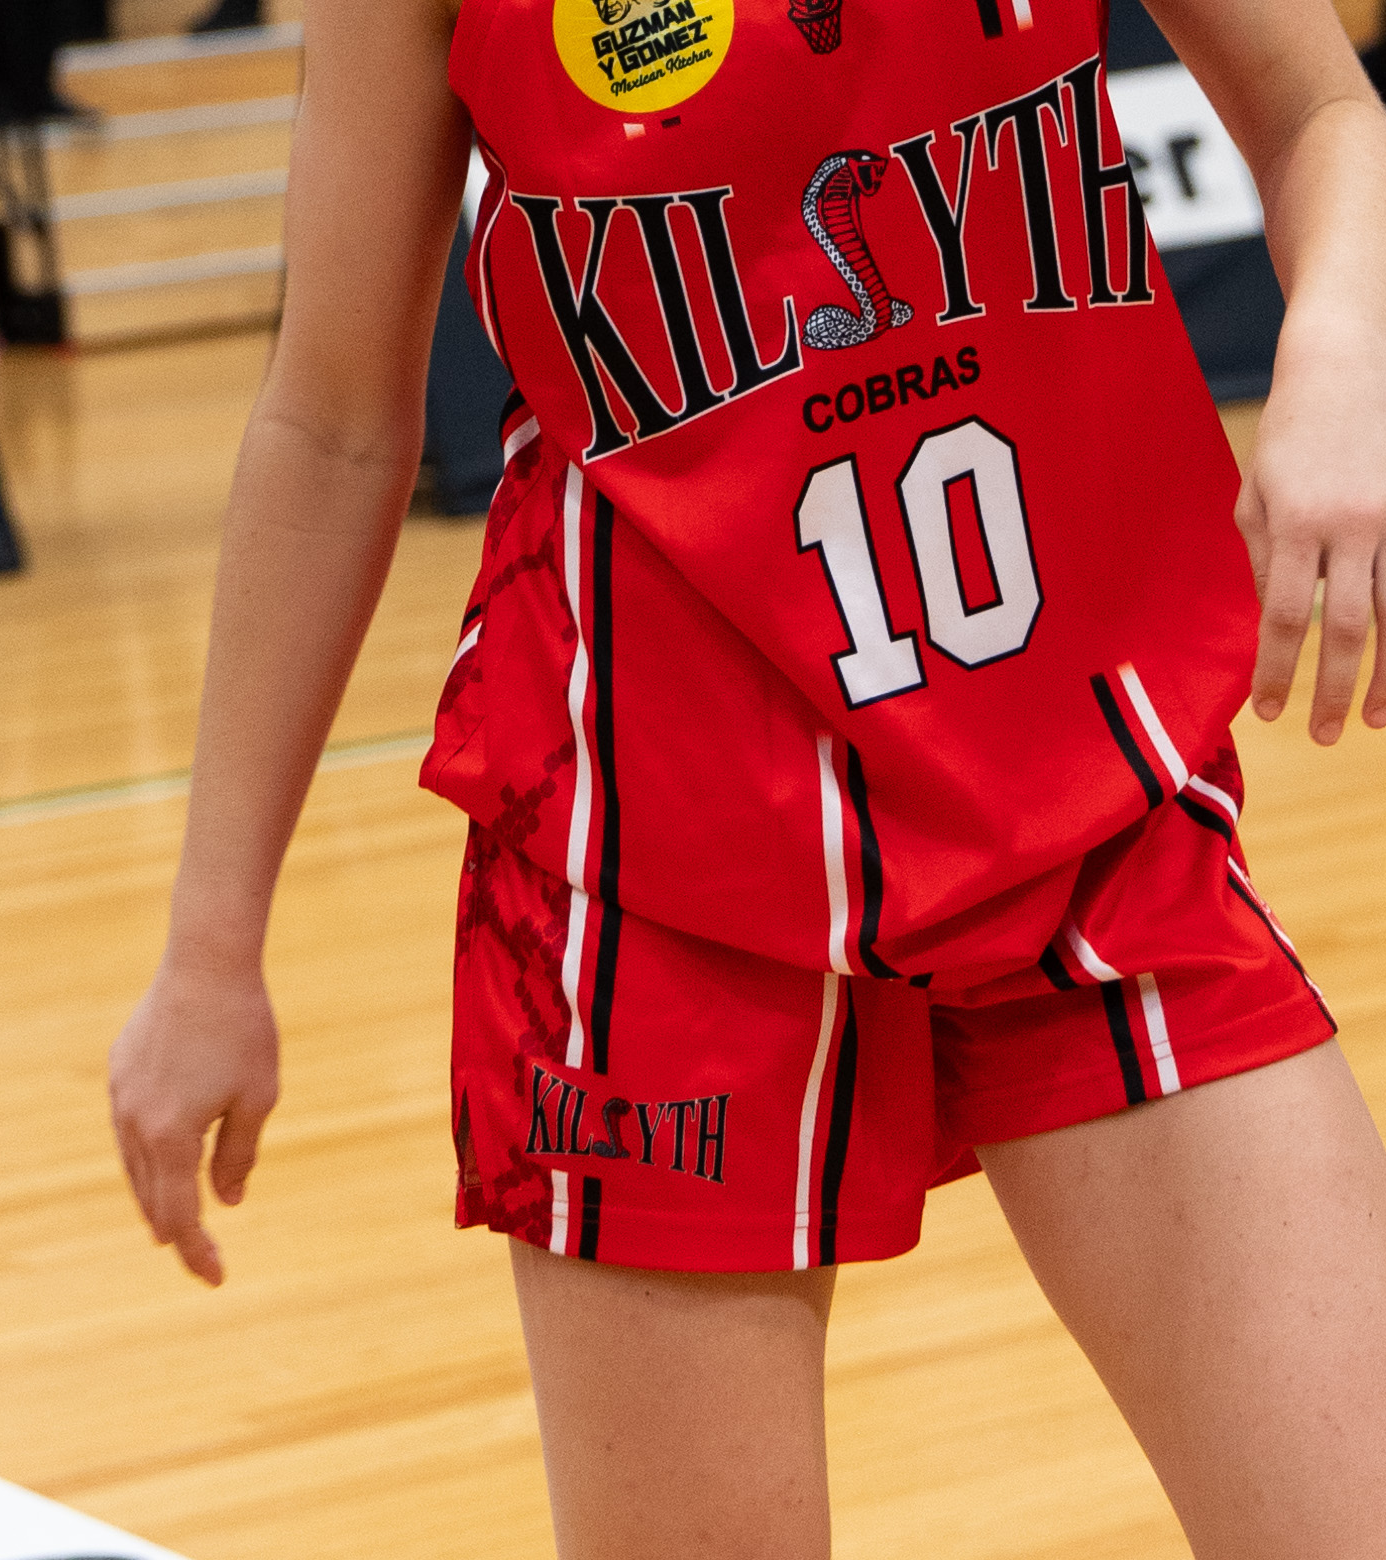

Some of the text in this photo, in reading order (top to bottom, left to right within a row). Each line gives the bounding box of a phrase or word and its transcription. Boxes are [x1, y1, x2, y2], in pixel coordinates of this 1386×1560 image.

[592, 0, 696, 59] GUZMAN
[597, 57, 615, 81] Y
[610, 49, 713, 97] Mexican Kitchen
[802, 347, 981, 434] COBRAS
[793, 415, 1045, 711] 10
